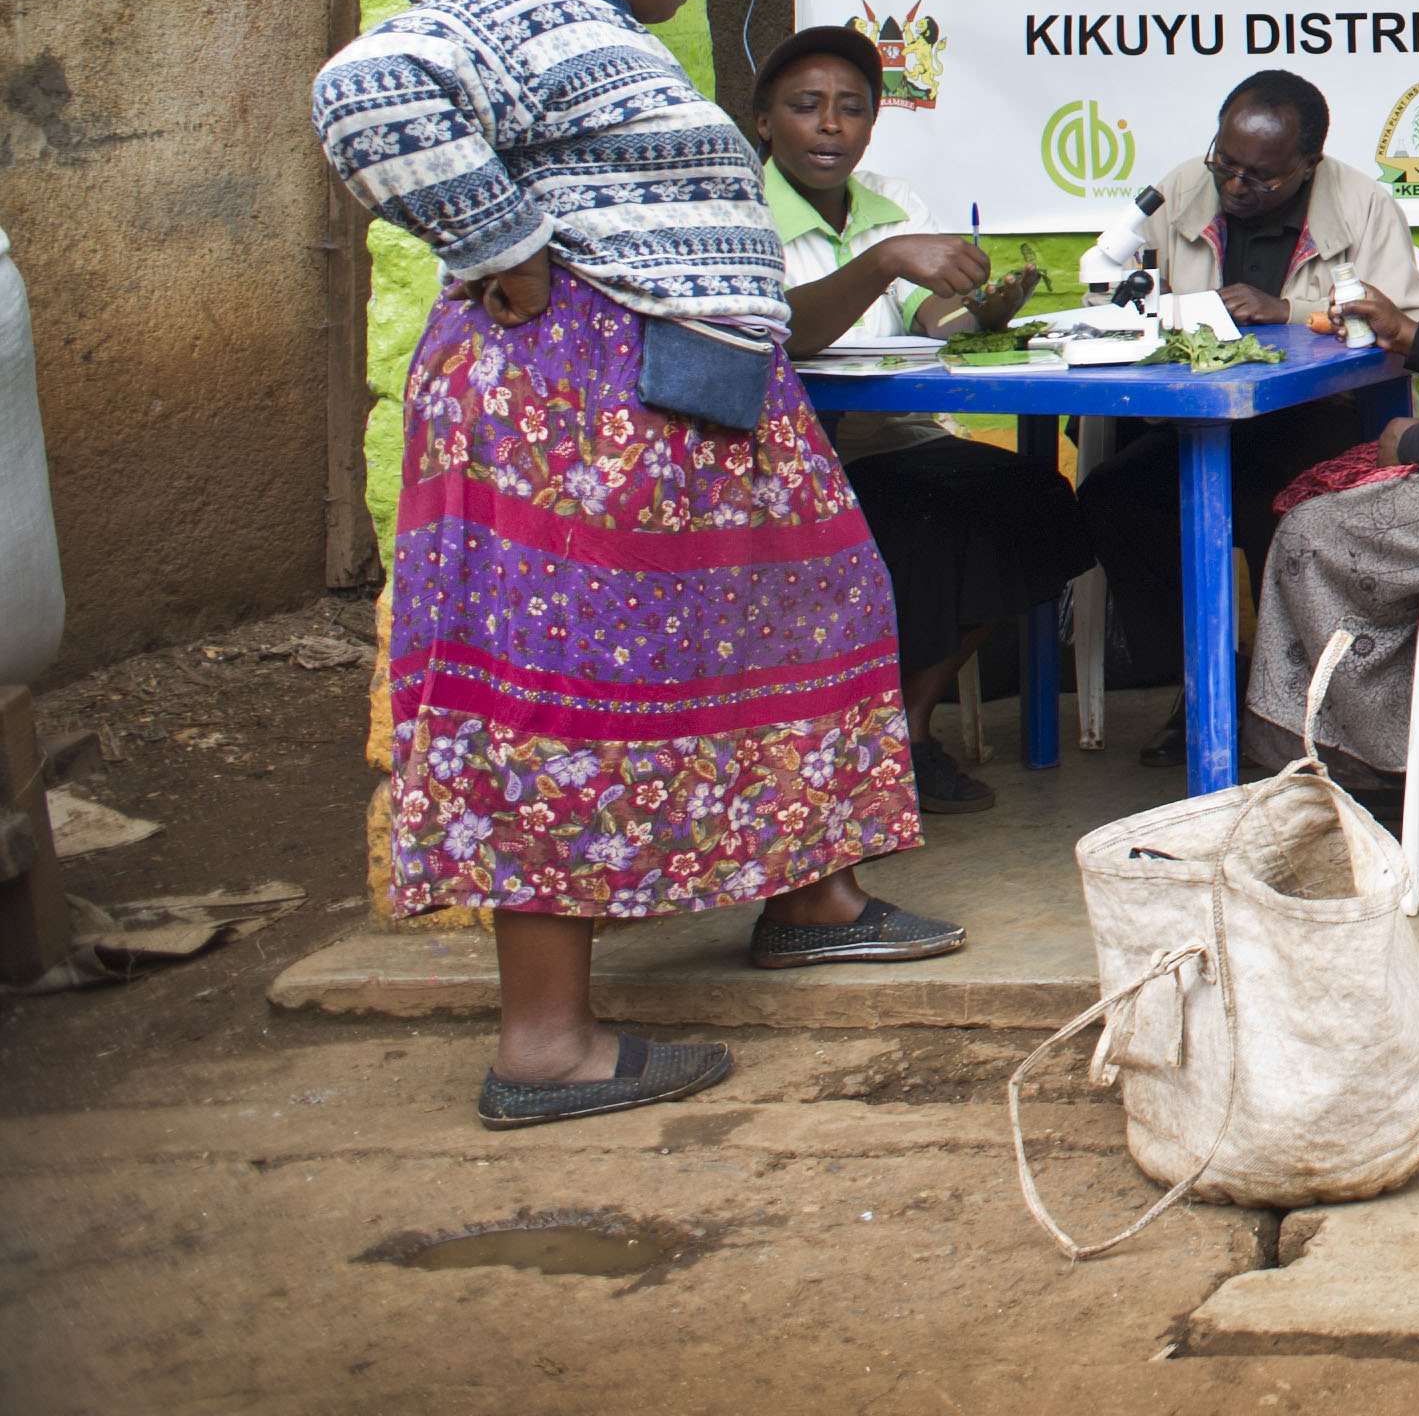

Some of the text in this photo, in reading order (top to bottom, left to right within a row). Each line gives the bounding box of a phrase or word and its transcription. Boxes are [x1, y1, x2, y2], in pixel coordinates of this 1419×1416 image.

[1025, 13, 1225, 57] KIKUYU
[1378, 128, 1392, 155] KENYA
[1389, 101, 1406, 127] PLANT
